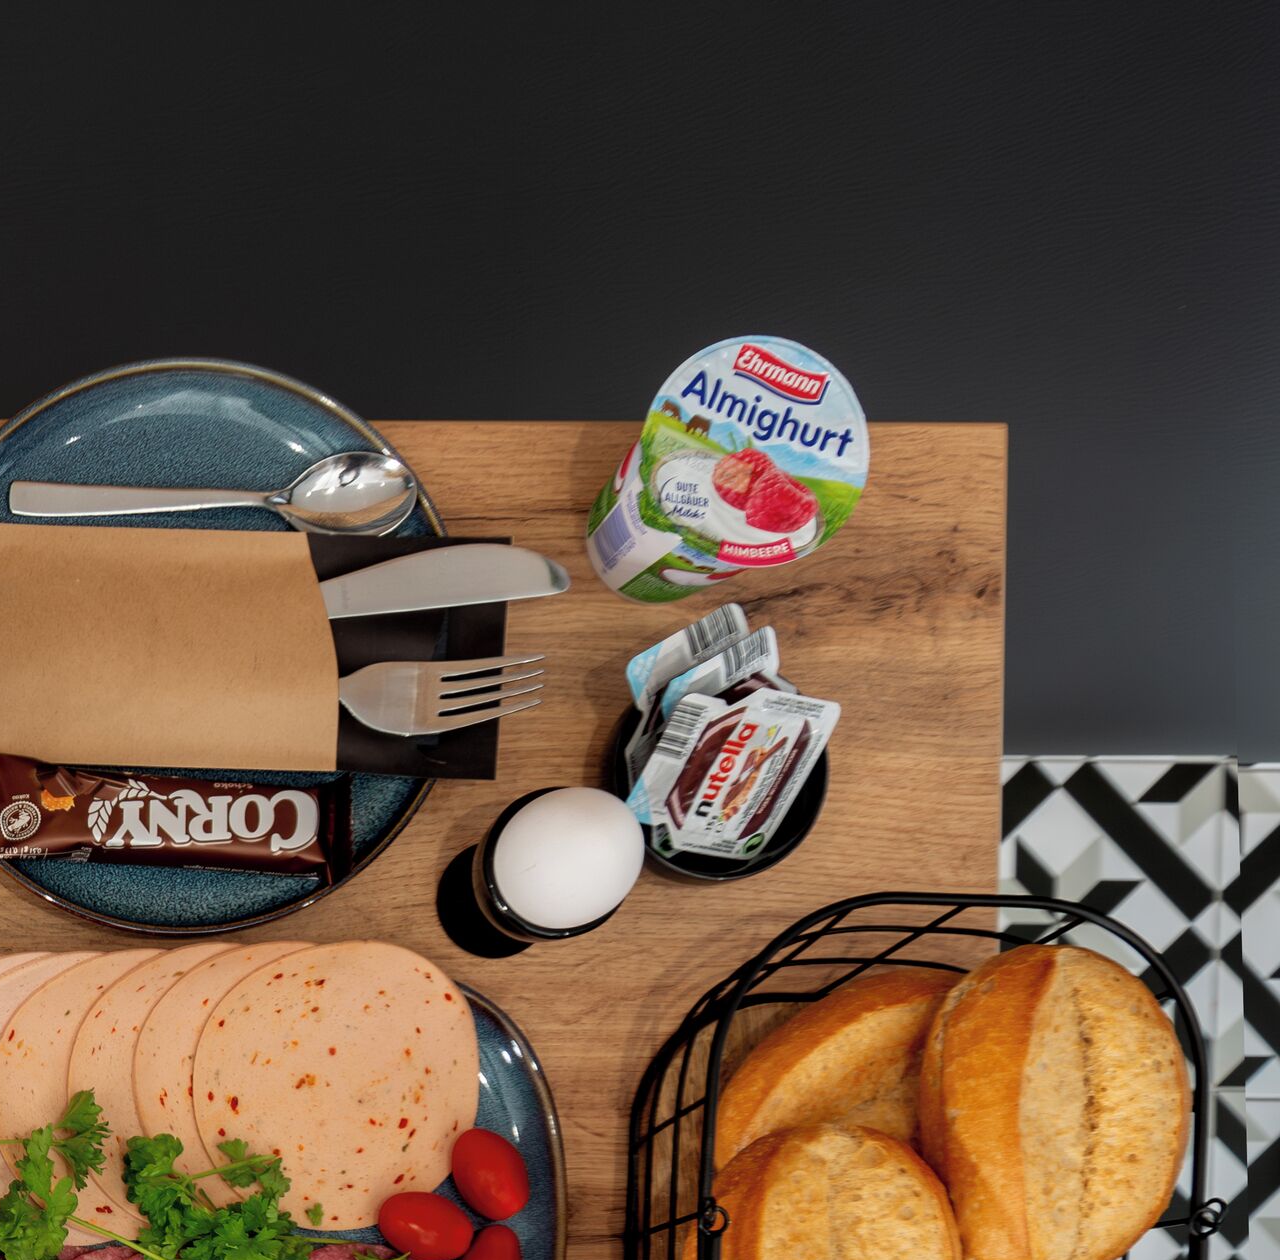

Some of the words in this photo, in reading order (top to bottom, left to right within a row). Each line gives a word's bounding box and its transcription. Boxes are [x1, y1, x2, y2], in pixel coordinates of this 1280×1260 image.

[736, 350, 821, 394] Ehrmann
[681, 371, 853, 457] Almighurt
[723, 541, 790, 555] HIMBEERE
[695, 723, 759, 817] nutella
[105, 789, 320, 854] CORNY
